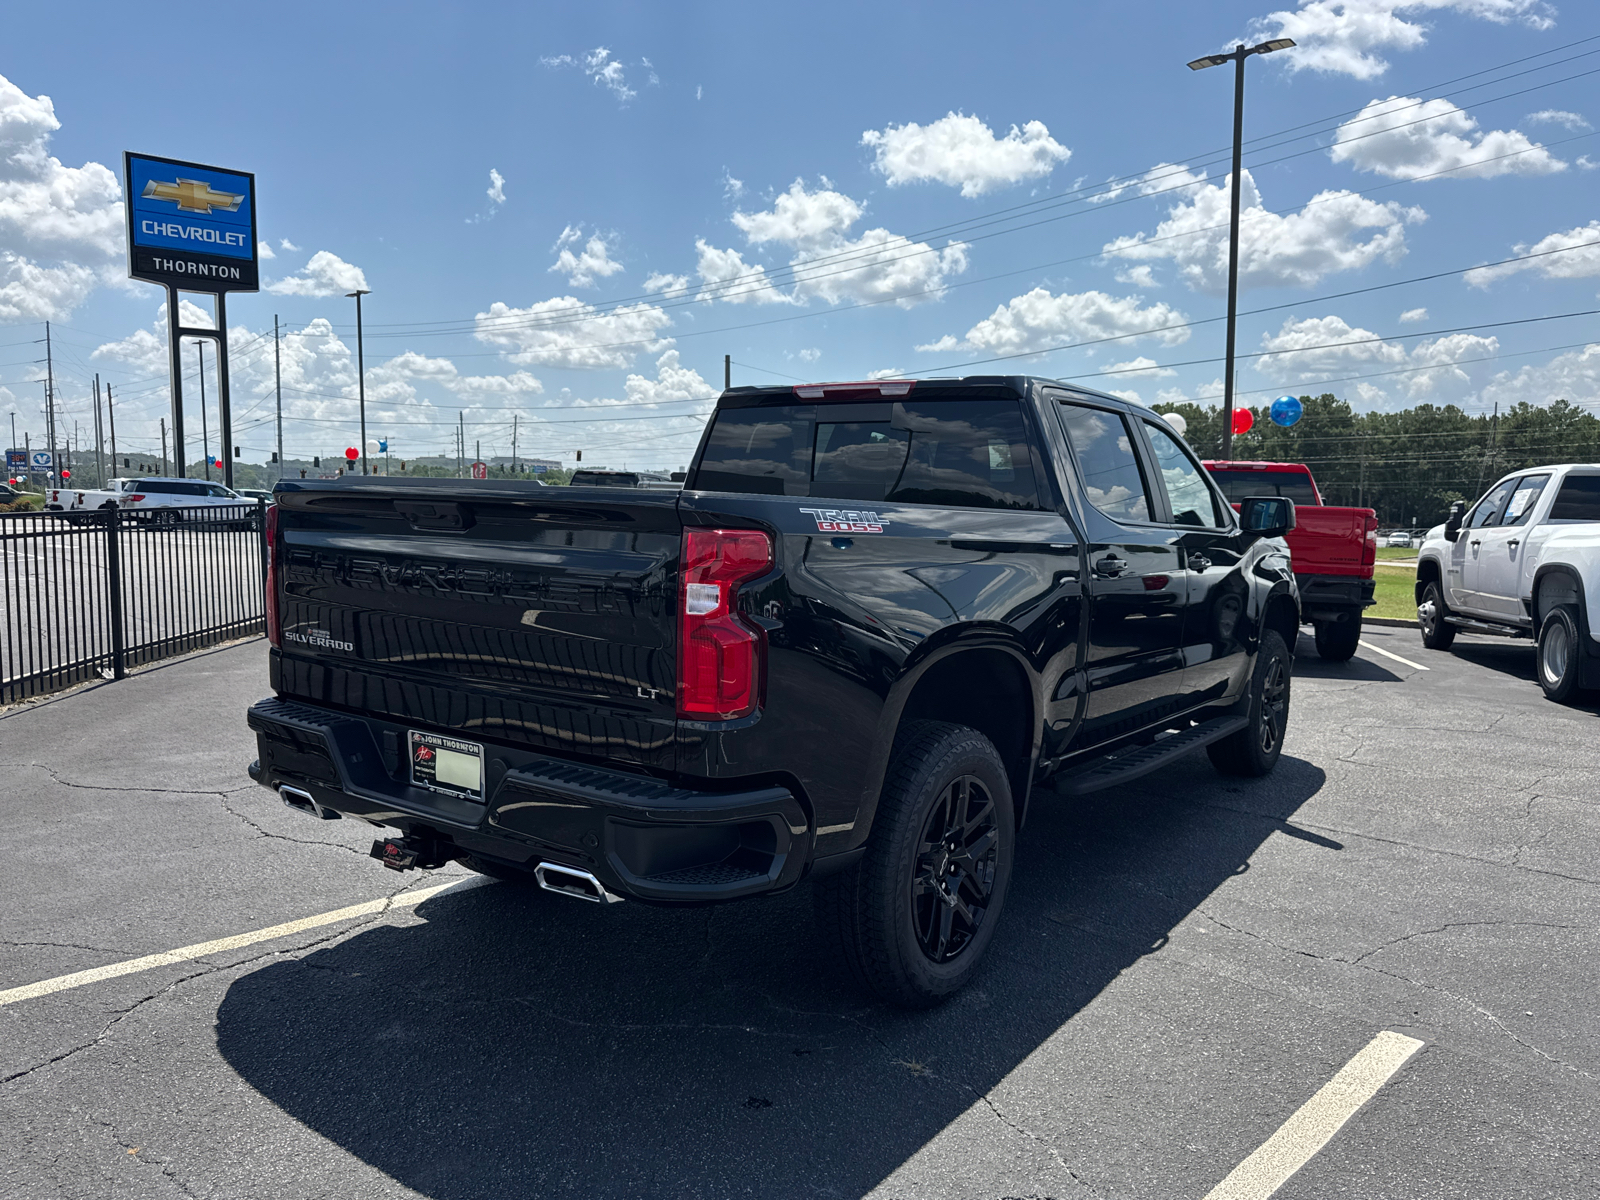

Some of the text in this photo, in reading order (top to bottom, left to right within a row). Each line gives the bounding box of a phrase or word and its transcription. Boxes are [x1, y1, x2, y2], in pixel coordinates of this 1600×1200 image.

[141, 220, 246, 247] CHEVROLET
[152, 257, 240, 280] THORNTON
[799, 507, 891, 526] TRAIL
[817, 521, 884, 534] BOSS
[285, 631, 354, 652] SILVERADO
[637, 686, 660, 700] LT
[424, 735, 479, 754] JOHN THORNTON
